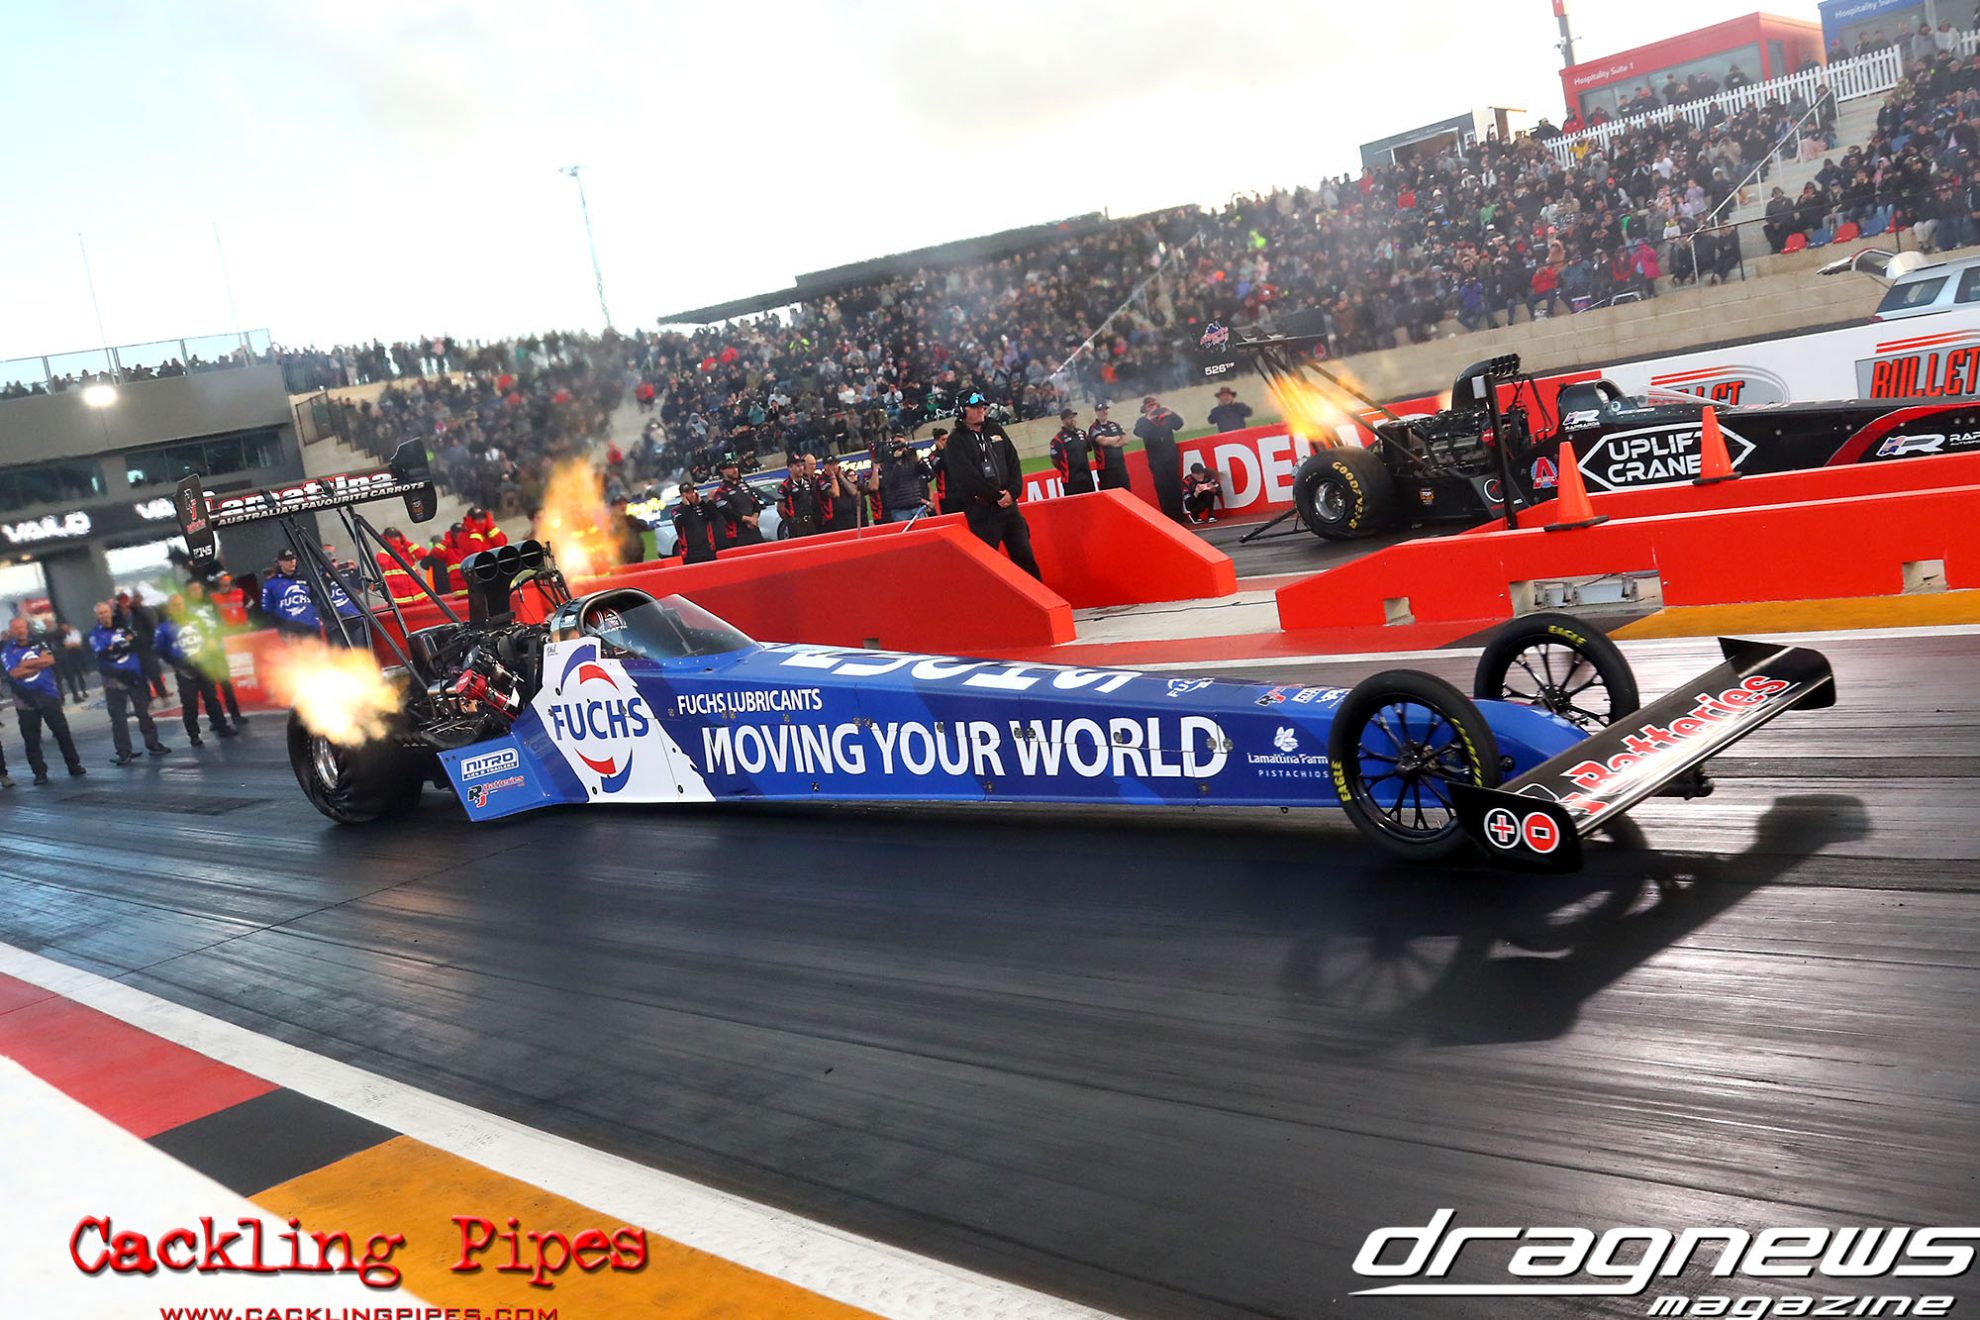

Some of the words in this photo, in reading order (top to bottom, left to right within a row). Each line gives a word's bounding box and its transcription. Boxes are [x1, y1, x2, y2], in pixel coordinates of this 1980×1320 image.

[217, 504, 300, 527] AUSTRALIA'S
[301, 491, 368, 511] FAVOURITE
[369, 482, 425, 498] CARROTS
[550, 698, 650, 741] FUCHS
[677, 692, 725, 715] FUCHS
[727, 689, 823, 712] LUBRICANTS
[702, 723, 867, 775] MOVING
[869, 720, 1005, 776] YOUR
[1009, 716, 1229, 777] WORLD
[1560, 675, 1790, 795] Batteries
[466, 752, 514, 771] NITRO
[1248, 752, 1299, 764] Lamattina
[1259, 770, 1329, 778] PISTACHIOS
[1331, 760, 1351, 801] EAGLE
